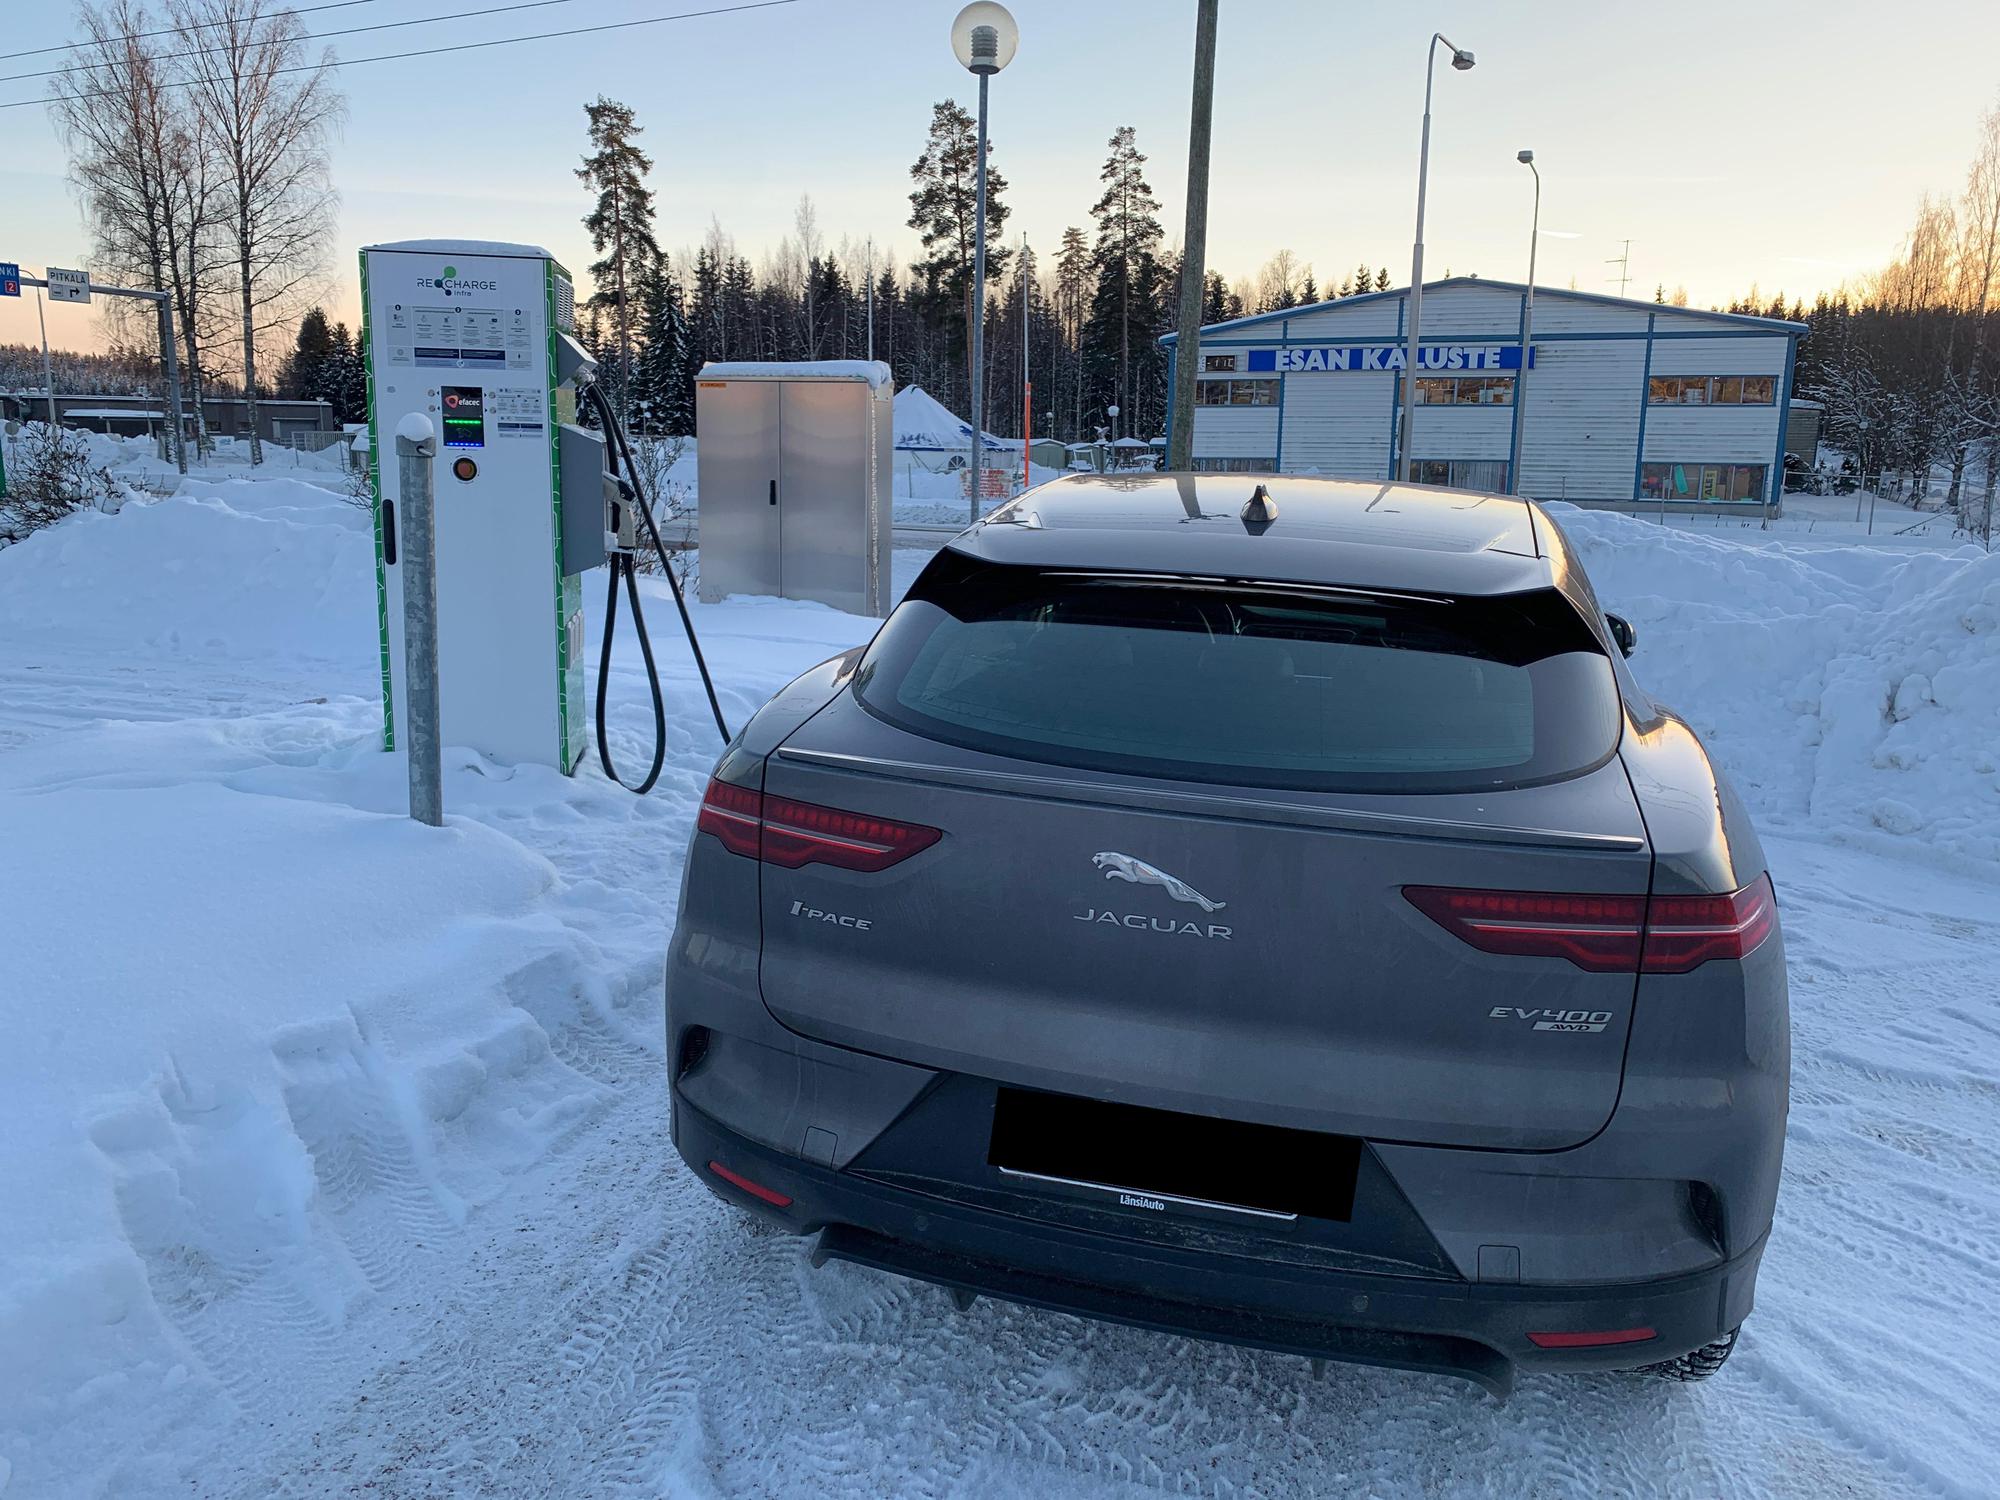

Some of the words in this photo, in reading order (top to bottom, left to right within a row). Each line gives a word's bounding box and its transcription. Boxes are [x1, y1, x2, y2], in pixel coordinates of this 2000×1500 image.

[8, 283, 15, 292] 2
[1275, 349, 1351, 371] ESAN
[459, 398, 480, 406] efacec
[1073, 908, 1233, 941] JAGUAR
[1488, 1006, 1613, 1023] EV400
[1549, 1024, 1590, 1032] AWD
[1120, 1194, 1164, 1211] LänsiAuto
